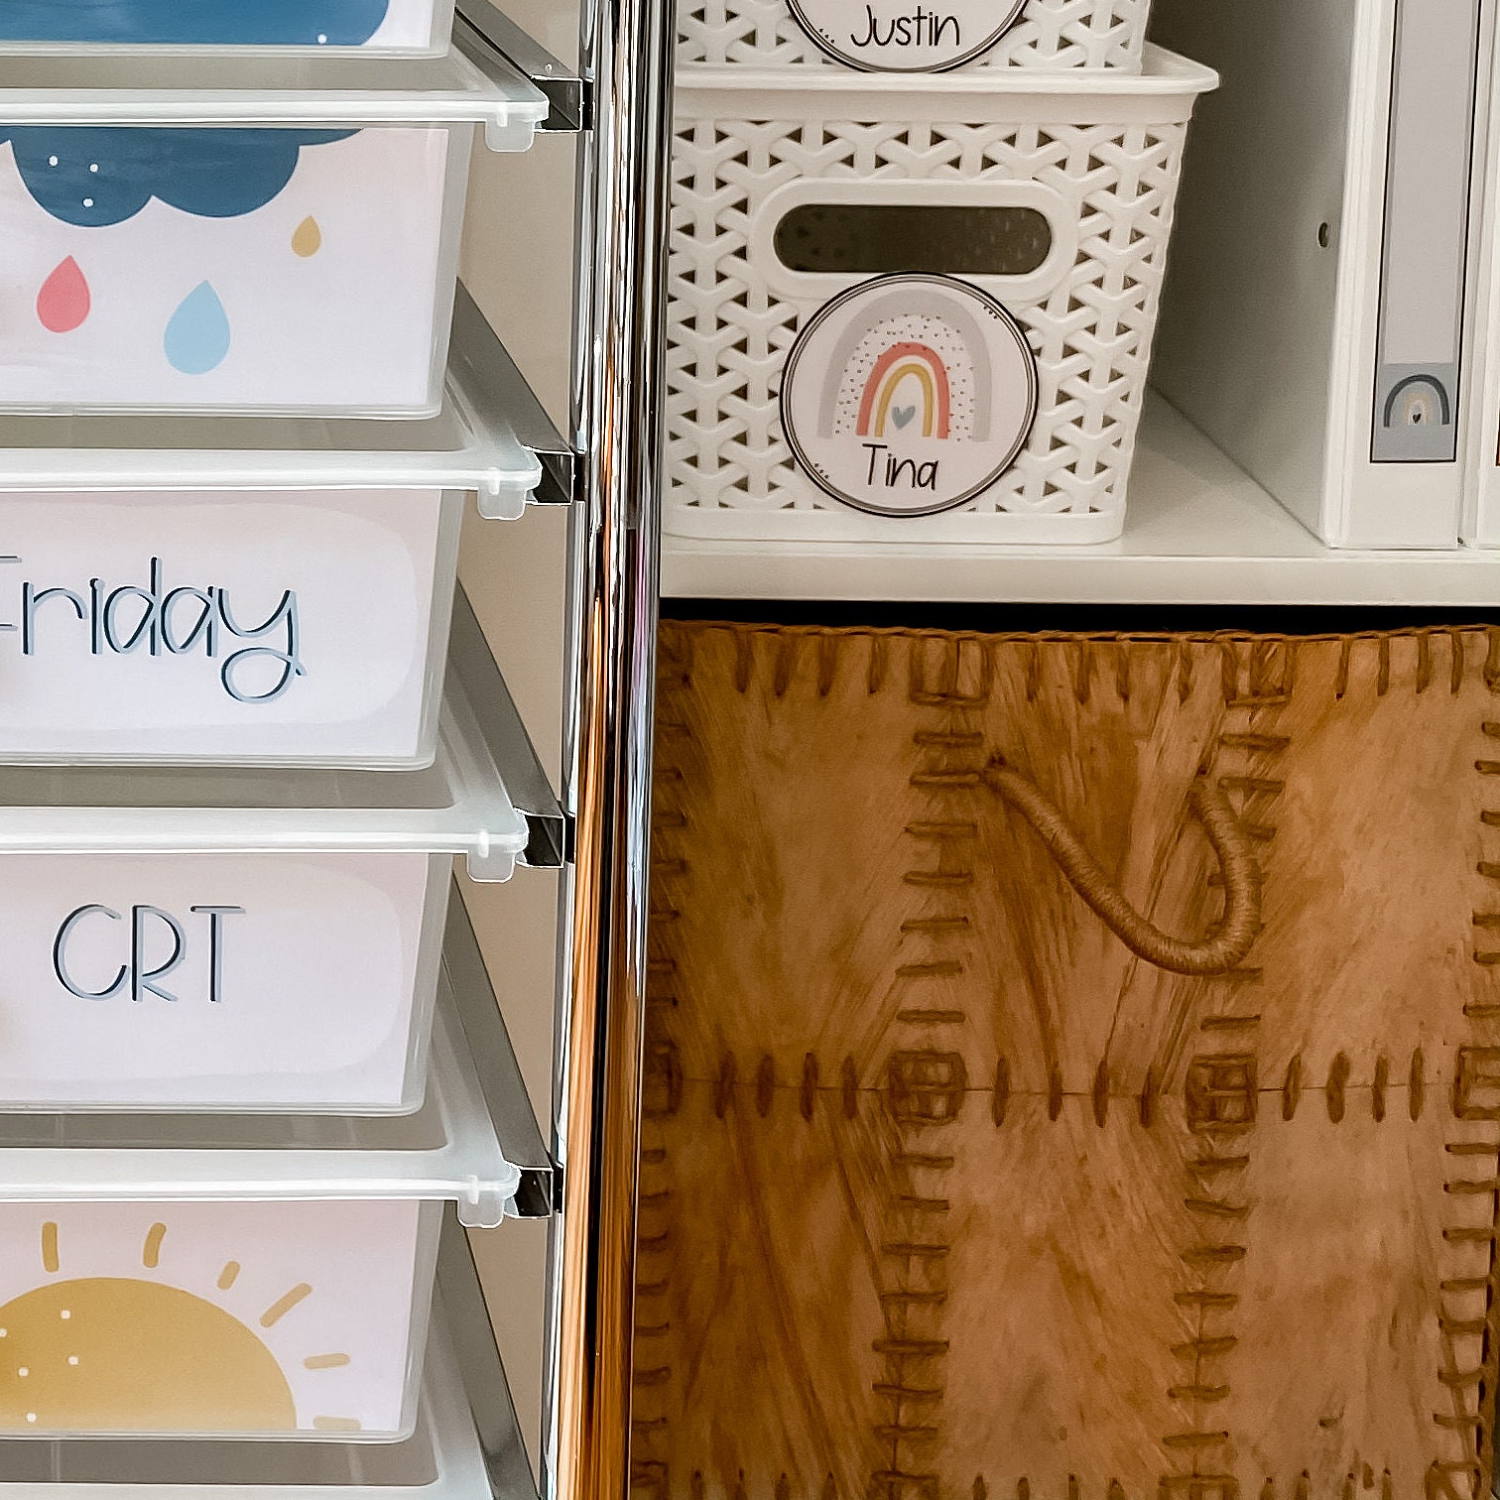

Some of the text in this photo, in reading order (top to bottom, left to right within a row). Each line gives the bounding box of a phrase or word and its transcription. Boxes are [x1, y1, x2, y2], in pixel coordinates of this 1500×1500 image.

[850, 4, 962, 49] Justin
[861, 444, 939, 492] Tina
[52, 903, 246, 1002] CRT
